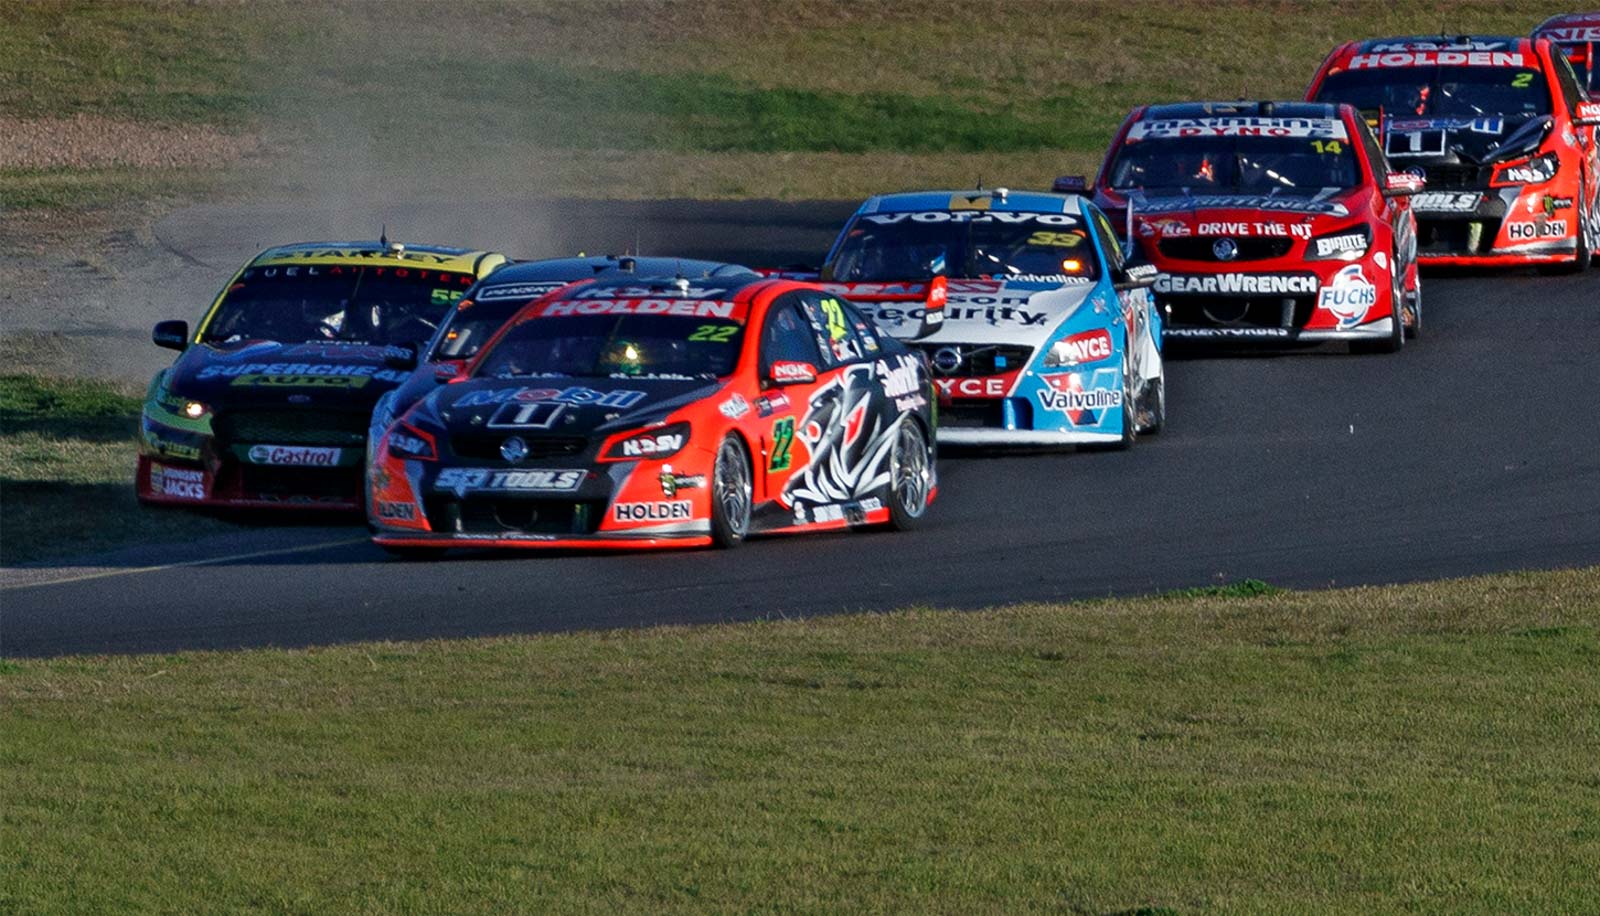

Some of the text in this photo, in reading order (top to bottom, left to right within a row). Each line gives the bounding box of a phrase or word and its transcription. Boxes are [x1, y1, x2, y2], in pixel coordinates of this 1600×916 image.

[1349, 53, 1524, 69] HOLDEN
[1511, 73, 1534, 88] 2
[1179, 127, 1291, 136] DYNO
[1310, 140, 1342, 154] 14
[1411, 192, 1477, 209] OOLS
[1197, 222, 1249, 236] DRIVE
[1252, 222, 1288, 236] THE
[1026, 231, 1084, 248] 33
[1321, 286, 1376, 306] FUCHS
[542, 300, 734, 318] HOLDEN
[687, 324, 739, 342] 22
[935, 378, 1004, 396] YCE
[1038, 388, 1121, 409] Valvoline
[769, 416, 796, 473] 22
[270, 449, 335, 466] Castrol
[490, 471, 580, 489] TOOLS
[615, 502, 691, 520] HOLDEN
